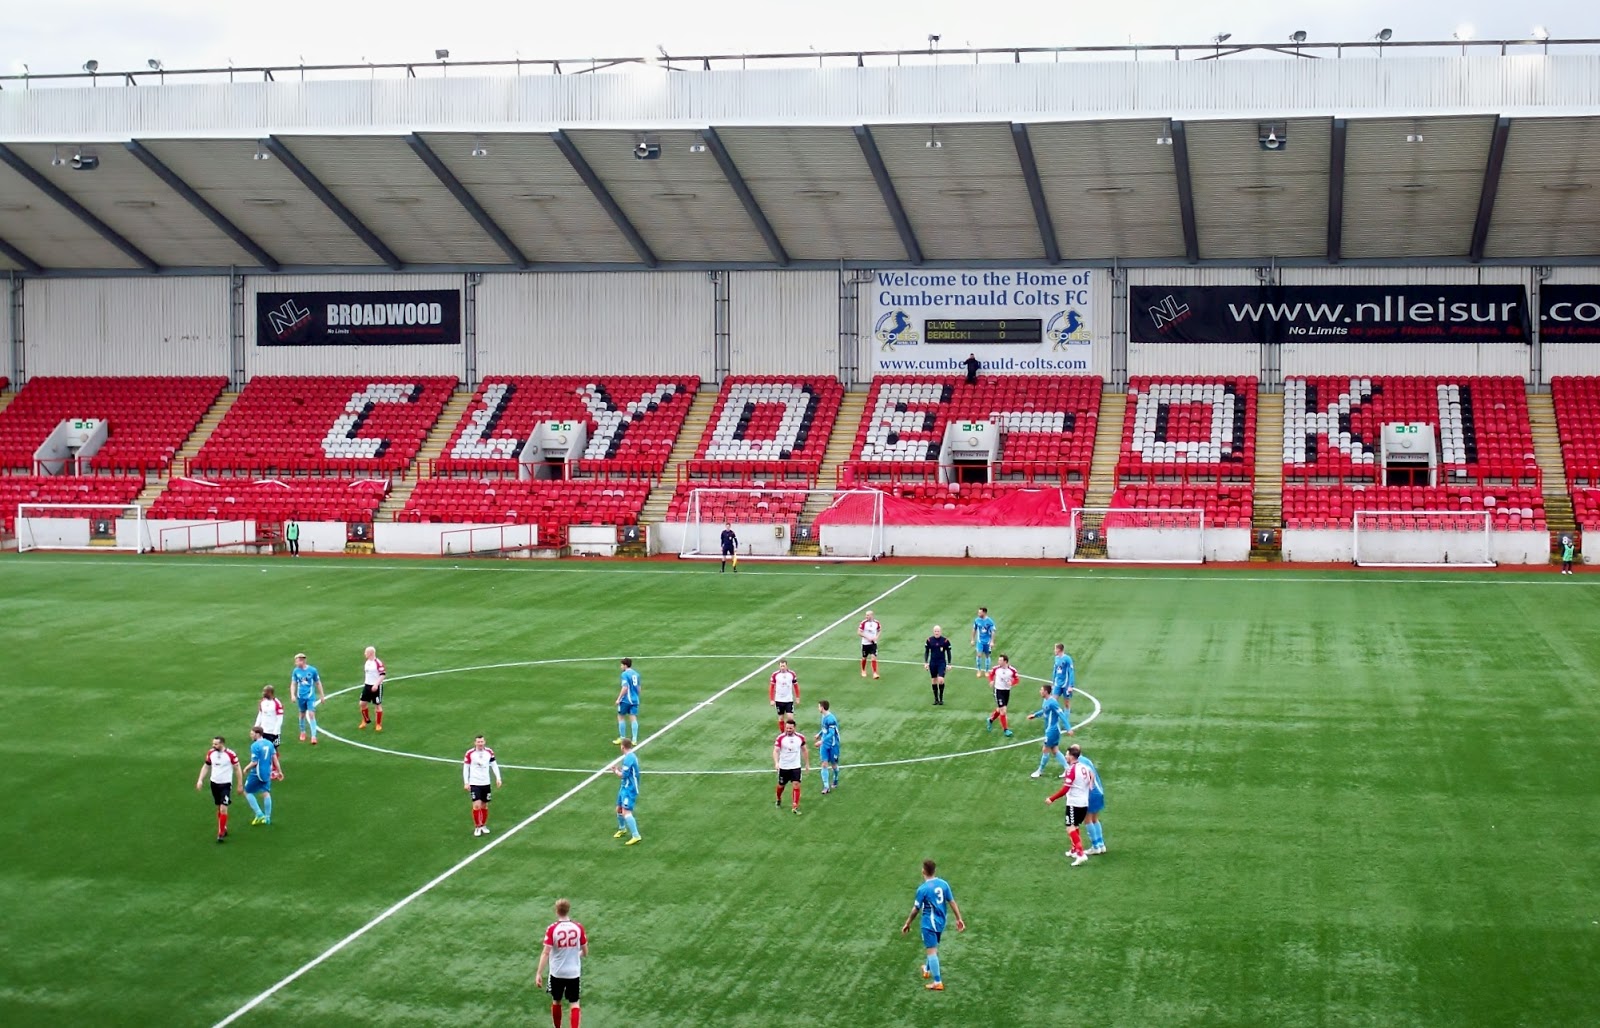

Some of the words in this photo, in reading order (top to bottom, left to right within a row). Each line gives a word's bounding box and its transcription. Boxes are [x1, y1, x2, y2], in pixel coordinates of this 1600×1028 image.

[878, 272, 957, 286] Welcome
[961, 273, 978, 286] to
[983, 272, 1011, 285] the
[1016, 272, 1067, 285] Home
[1072, 271, 1091, 285] of
[879, 290, 1008, 306] Cumbernauld
[1013, 290, 1060, 305] Colts
[1065, 290, 1088, 305] FC
[326, 302, 442, 326] BROADWOOD
[927, 321, 956, 330] CLYDE
[1289, 327, 1307, 335] No
[1308, 326, 1348, 335] Limits
[880, 357, 1086, 369] www.cumbeauld-colts.com
[99, 523, 105, 532] 2
[357, 526, 363, 535] 3
[801, 528, 808, 537] 5
[628, 529, 635, 538] 4
[1087, 532, 1094, 540] 6
[1262, 533, 1269, 542] 7
[1562, 536, 1569, 545] 8
[631, 674, 638, 686] 9
[262, 745, 270, 760] 7
[1081, 766, 1088, 779] 9
[934, 887, 944, 904] 3
[557, 930, 578, 948] 22
